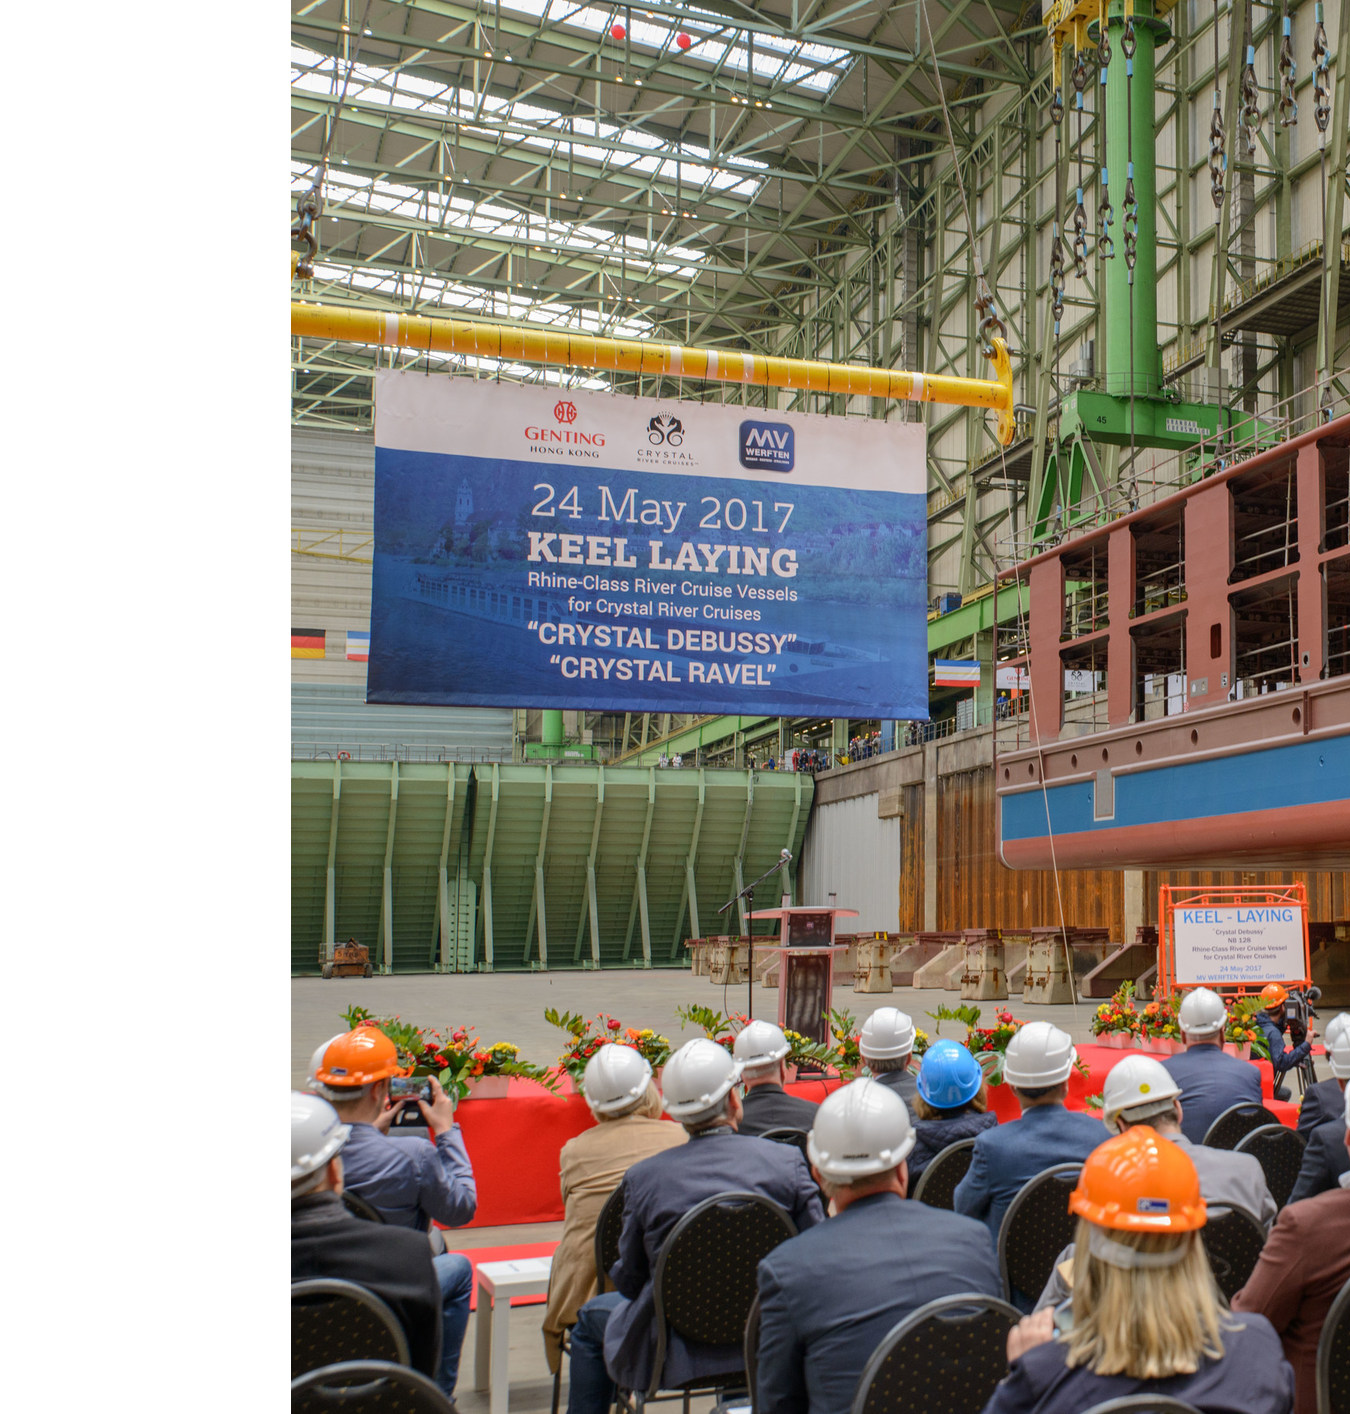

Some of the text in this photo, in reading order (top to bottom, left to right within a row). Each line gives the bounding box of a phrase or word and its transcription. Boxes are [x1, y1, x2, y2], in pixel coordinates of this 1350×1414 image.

[1096, 416, 1107, 424] 45
[524, 426, 606, 447] GENTING
[745, 428, 790, 450] MV
[530, 445, 600, 459] HONG KONG
[637, 449, 694, 460] CRYSTAL
[745, 447, 790, 460] WERFTEN
[531, 483, 795, 534] 24 May 2017
[527, 531, 799, 578] KEEL LAYING
[528, 571, 798, 602] Rhine-Class River Cruise Vessels
[567, 596, 761, 622] for Crystal River Cruises
[527, 620, 797, 655] “CRYSTAL DEBUSSY”
[549, 654, 777, 686] “CRYSTAL RAVEL”
[1183, 910, 1223, 924] KEEL
[1237, 908, 1293, 923] LAYING
